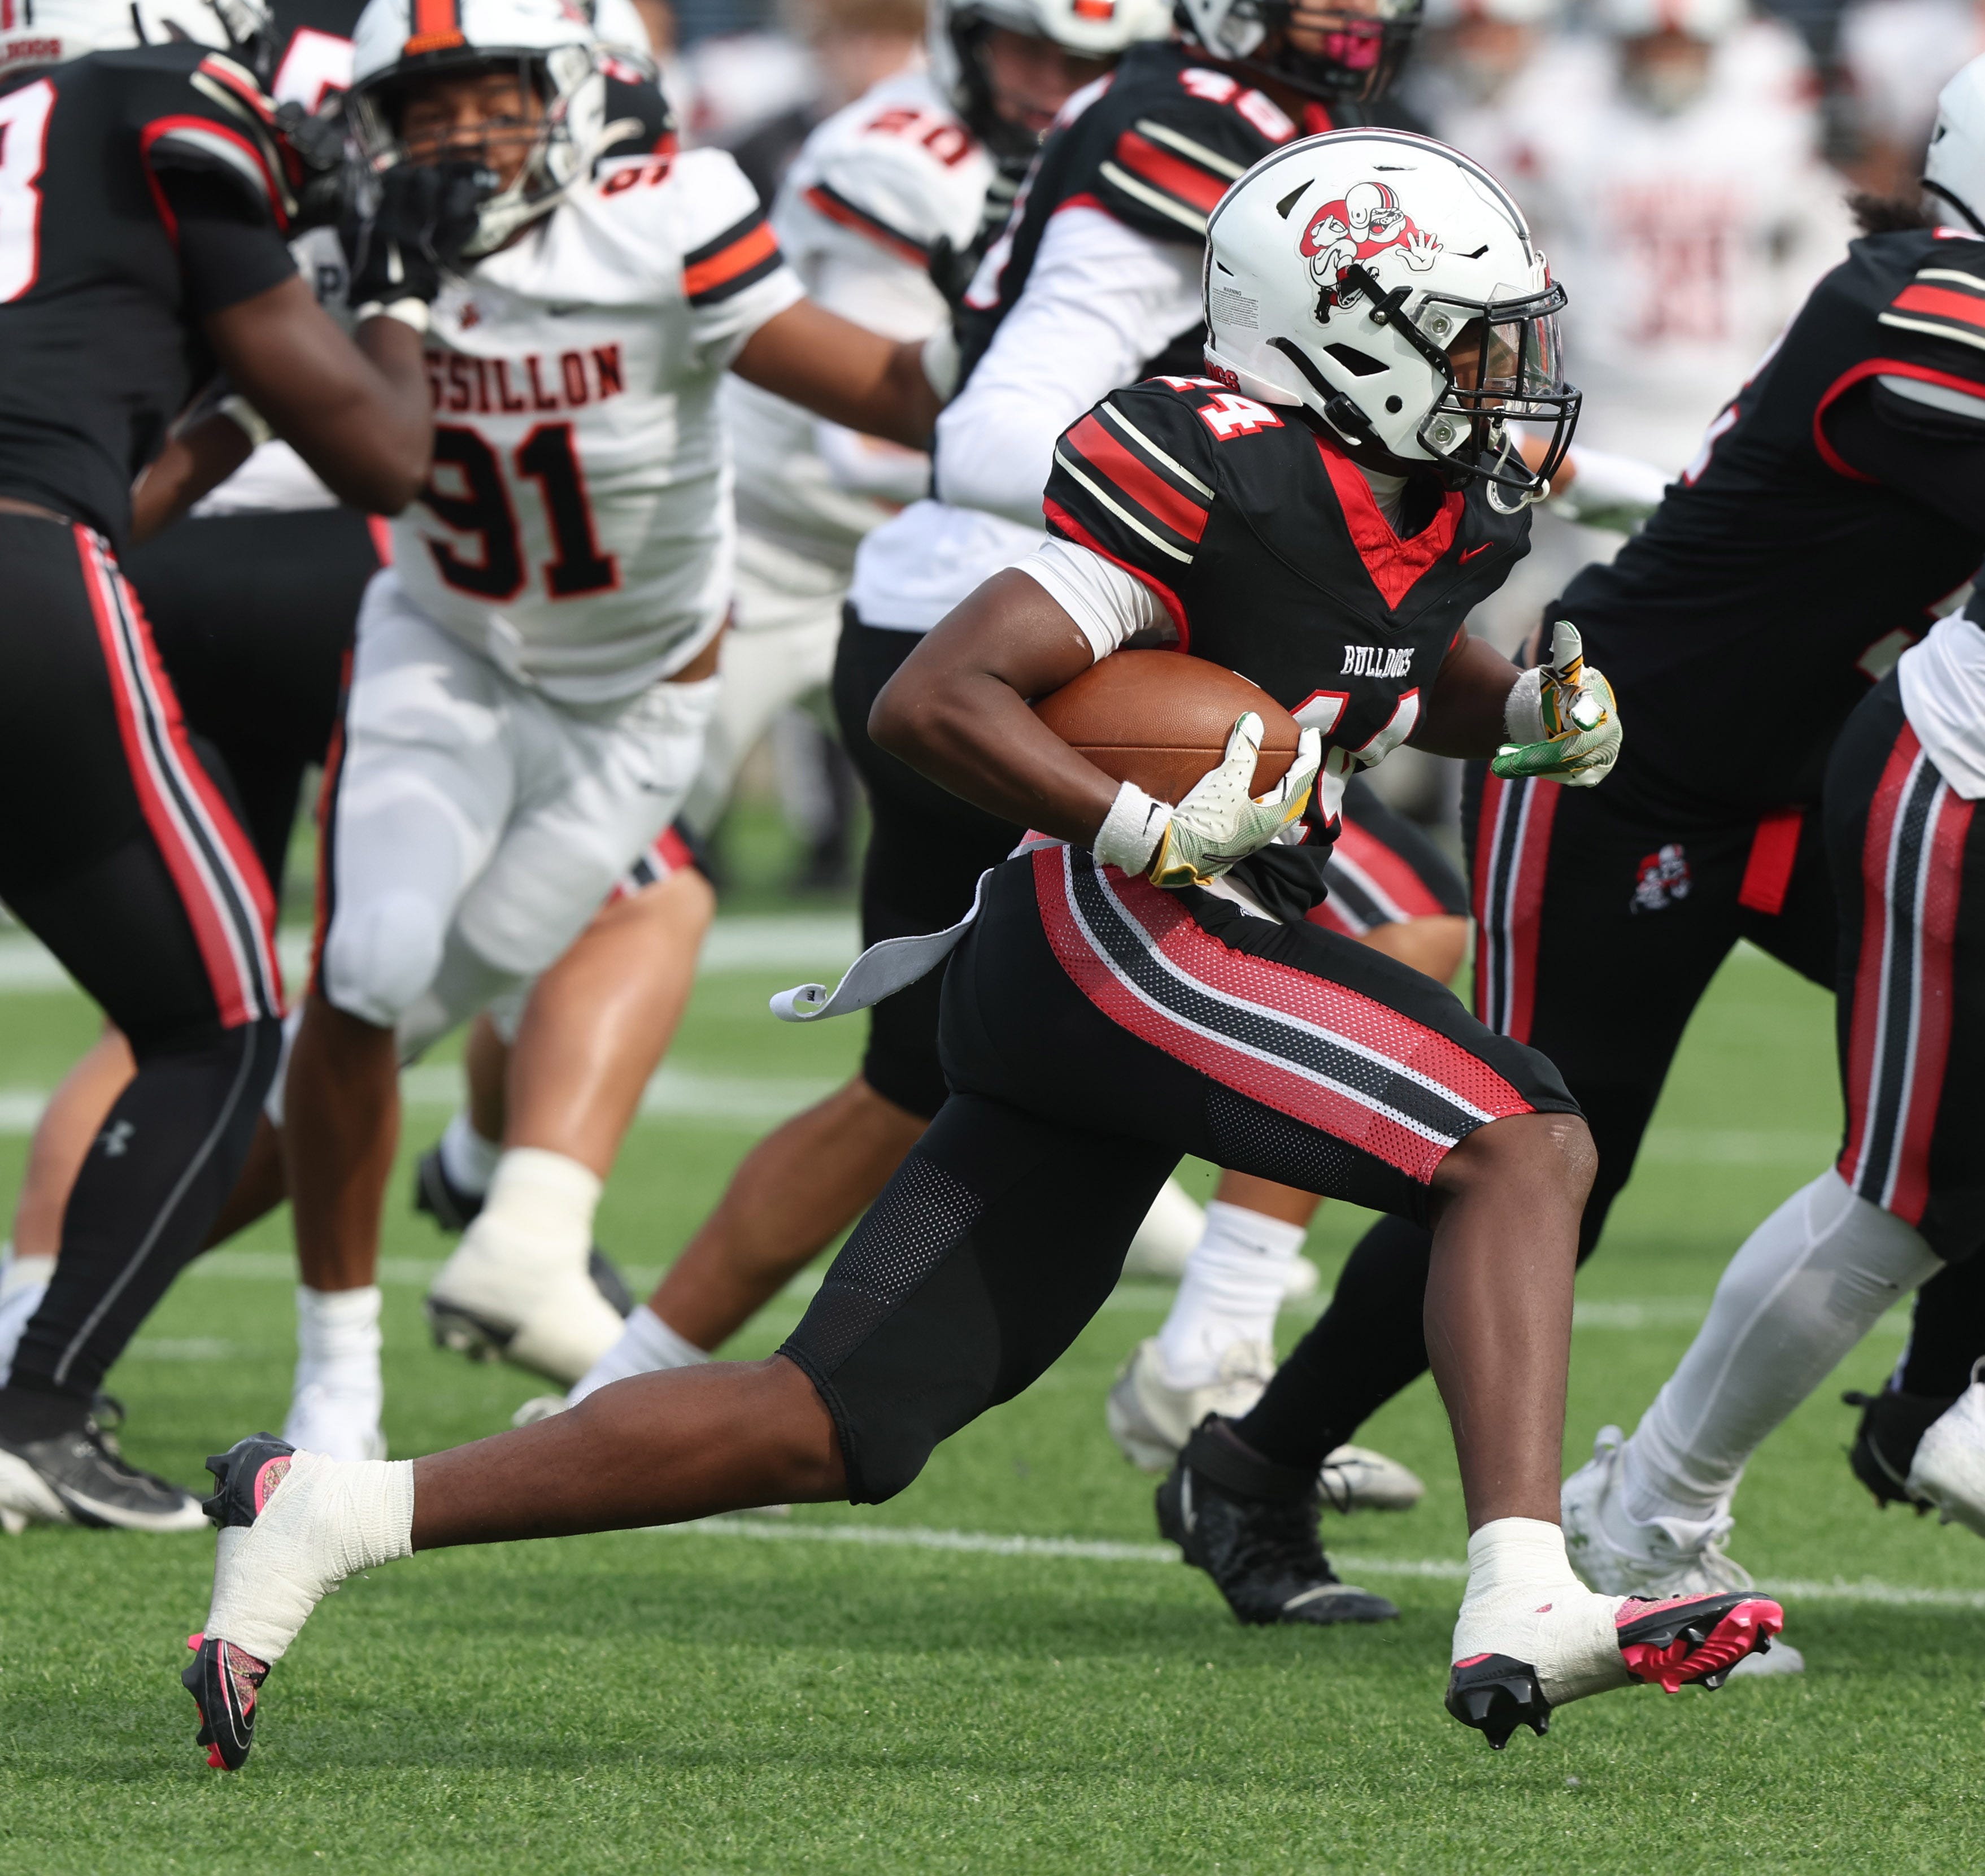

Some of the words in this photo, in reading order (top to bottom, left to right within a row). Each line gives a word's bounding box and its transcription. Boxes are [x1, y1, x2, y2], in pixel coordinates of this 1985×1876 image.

[1223, 286, 1242, 296] WARNING
[419, 420, 623, 604] 91
[1339, 645, 1415, 678] BULLDOGS
